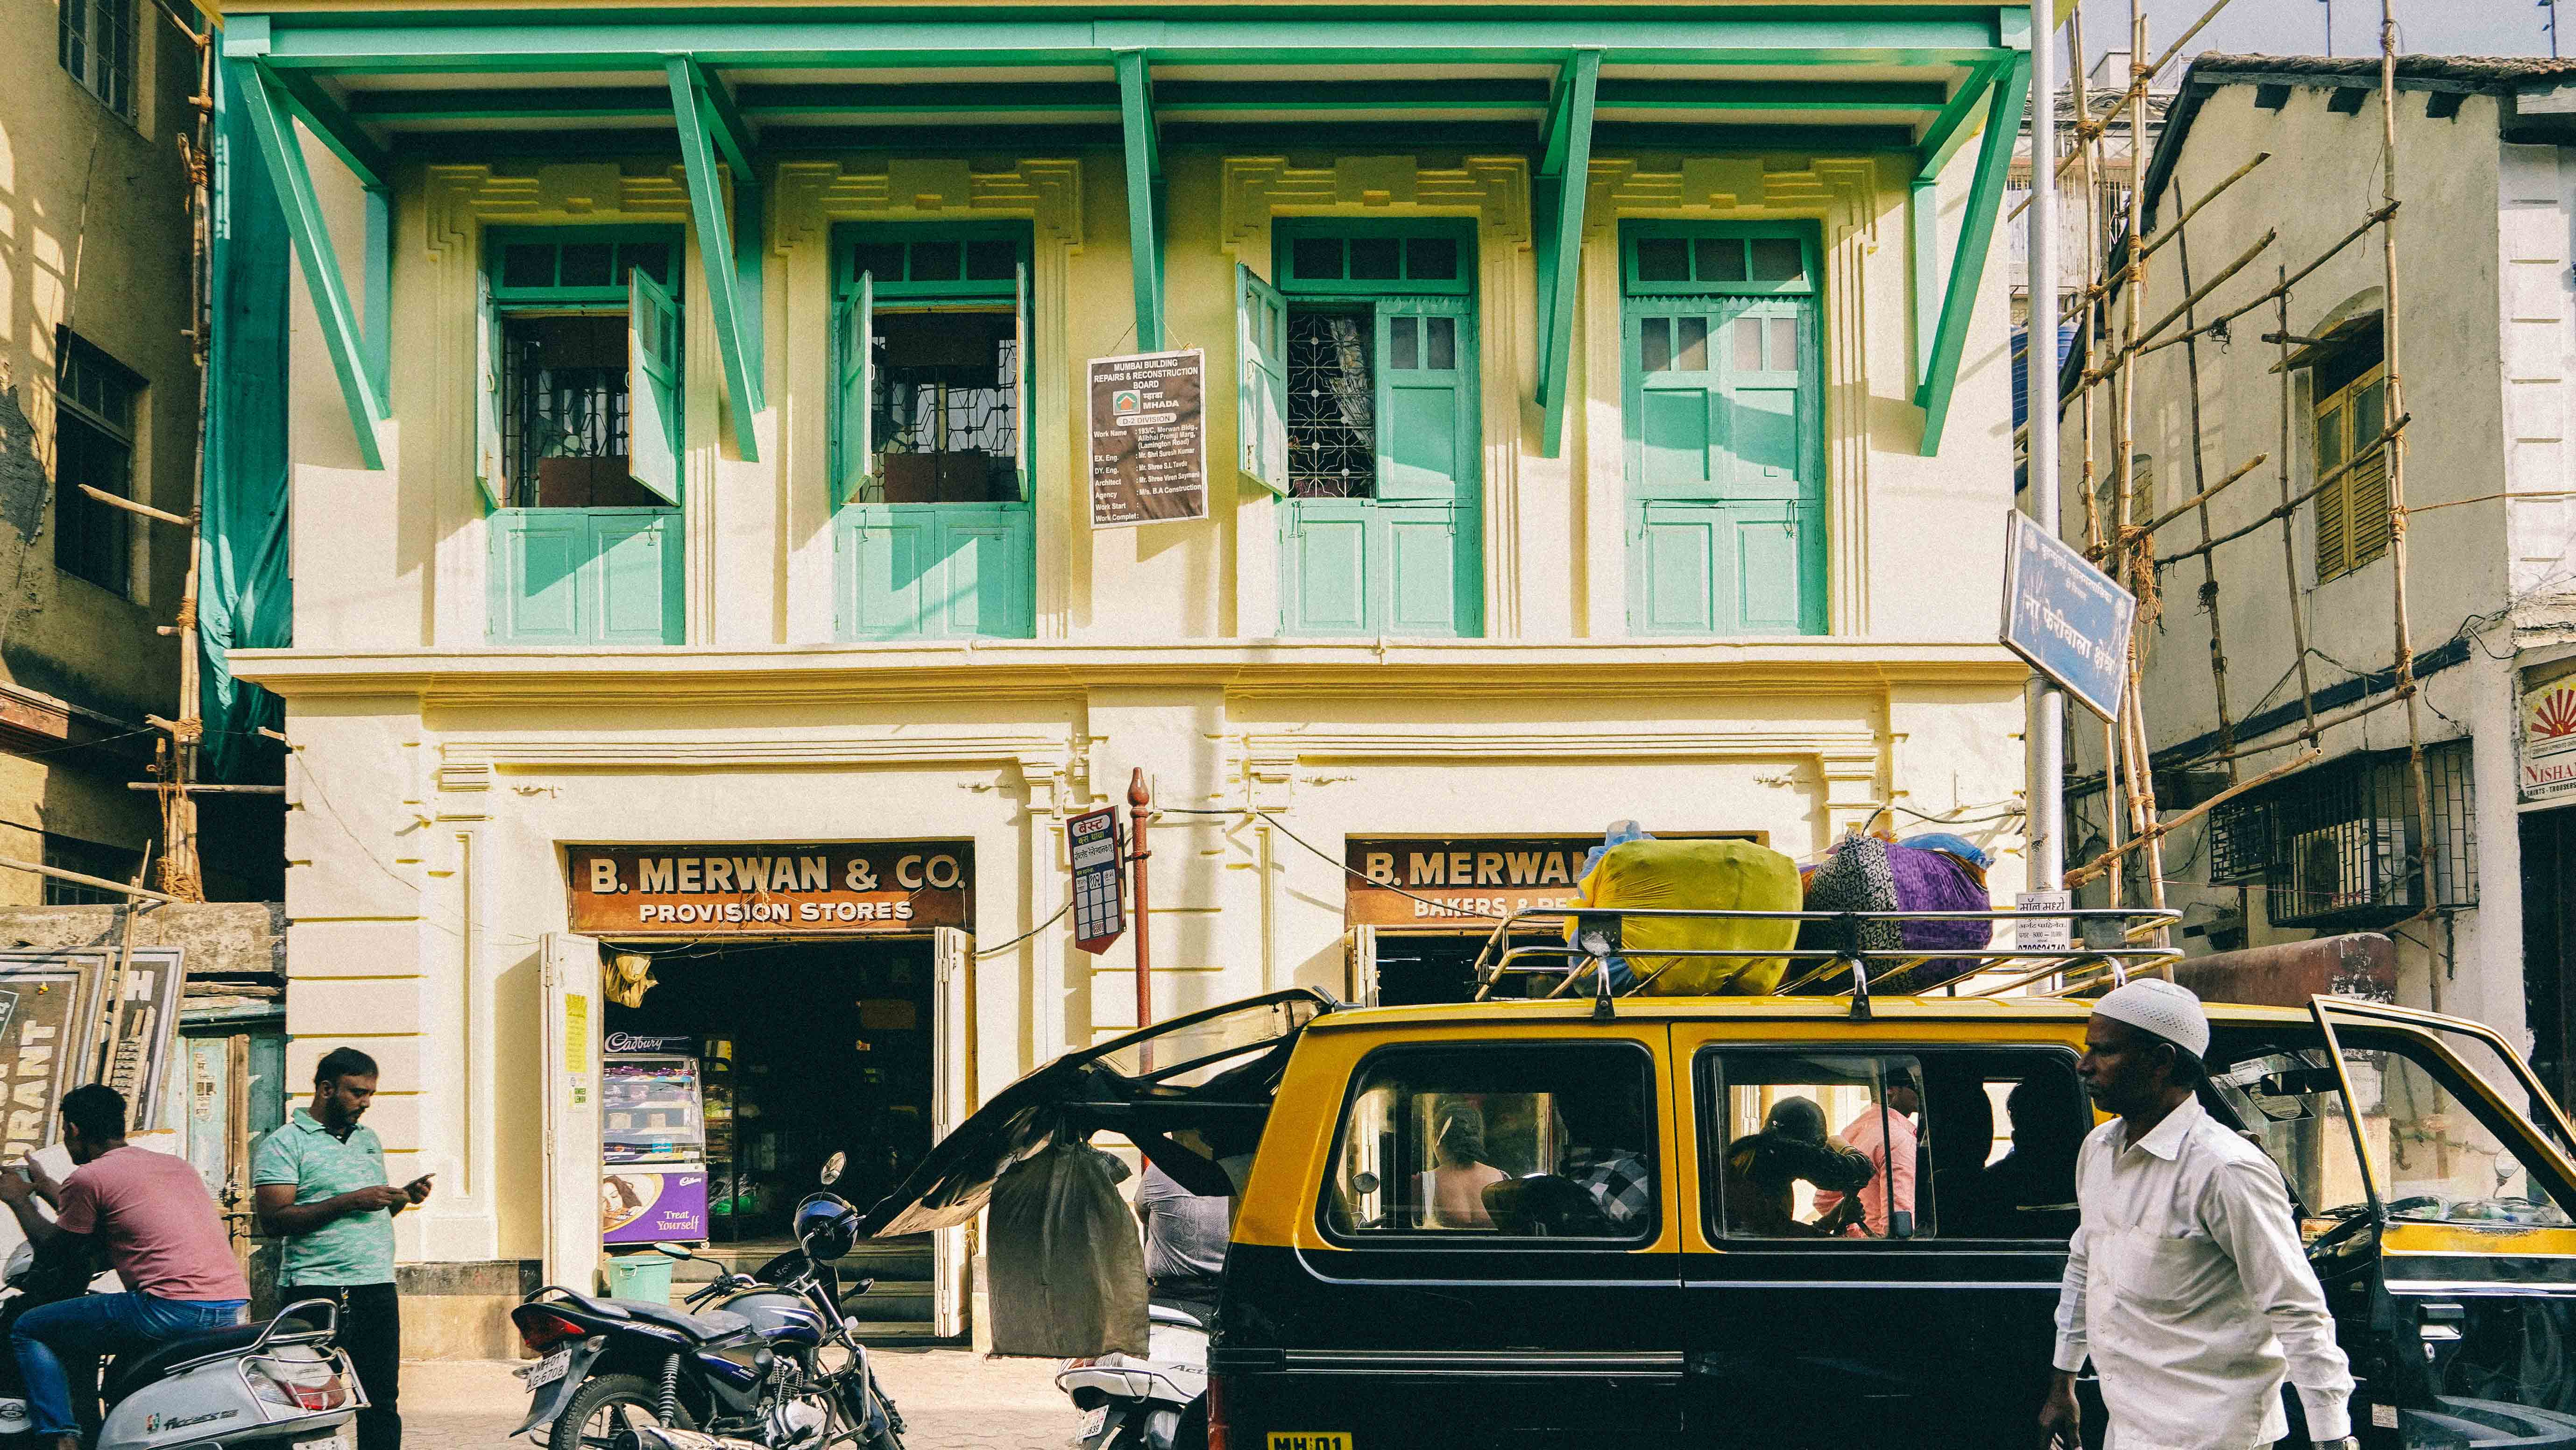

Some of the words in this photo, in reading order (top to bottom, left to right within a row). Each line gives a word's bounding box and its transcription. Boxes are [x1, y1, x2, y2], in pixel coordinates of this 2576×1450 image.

[1114, 363, 1143, 371] MUMBAI
[1144, 359, 1178, 369] BUILDING
[1094, 373, 1125, 383] REPAIRS
[1132, 367, 1198, 379] RECONSTRUCTION
[1133, 380, 1159, 389] BOARD
[1143, 399, 1179, 409] MHADA
[1164, 483, 1202, 493] Construction
[2525, 762, 2576, 785] NISHA
[1078, 818, 1103, 833] बेस्ट
[589, 858, 628, 893] B.
[639, 856, 829, 892] MERWAN
[846, 859, 878, 890] &
[894, 854, 967, 890] CO.
[1366, 853, 1401, 886] B.
[639, 902, 792, 923] PROVISION
[800, 901, 914, 921] STORES
[1414, 897, 1507, 917] BAKERS
[2020, 898, 2041, 911] मॉल
[604, 1031, 664, 1053] Cadbury
[659, 1211, 689, 1219] Treat
[657, 1215, 700, 1233] Yourself
